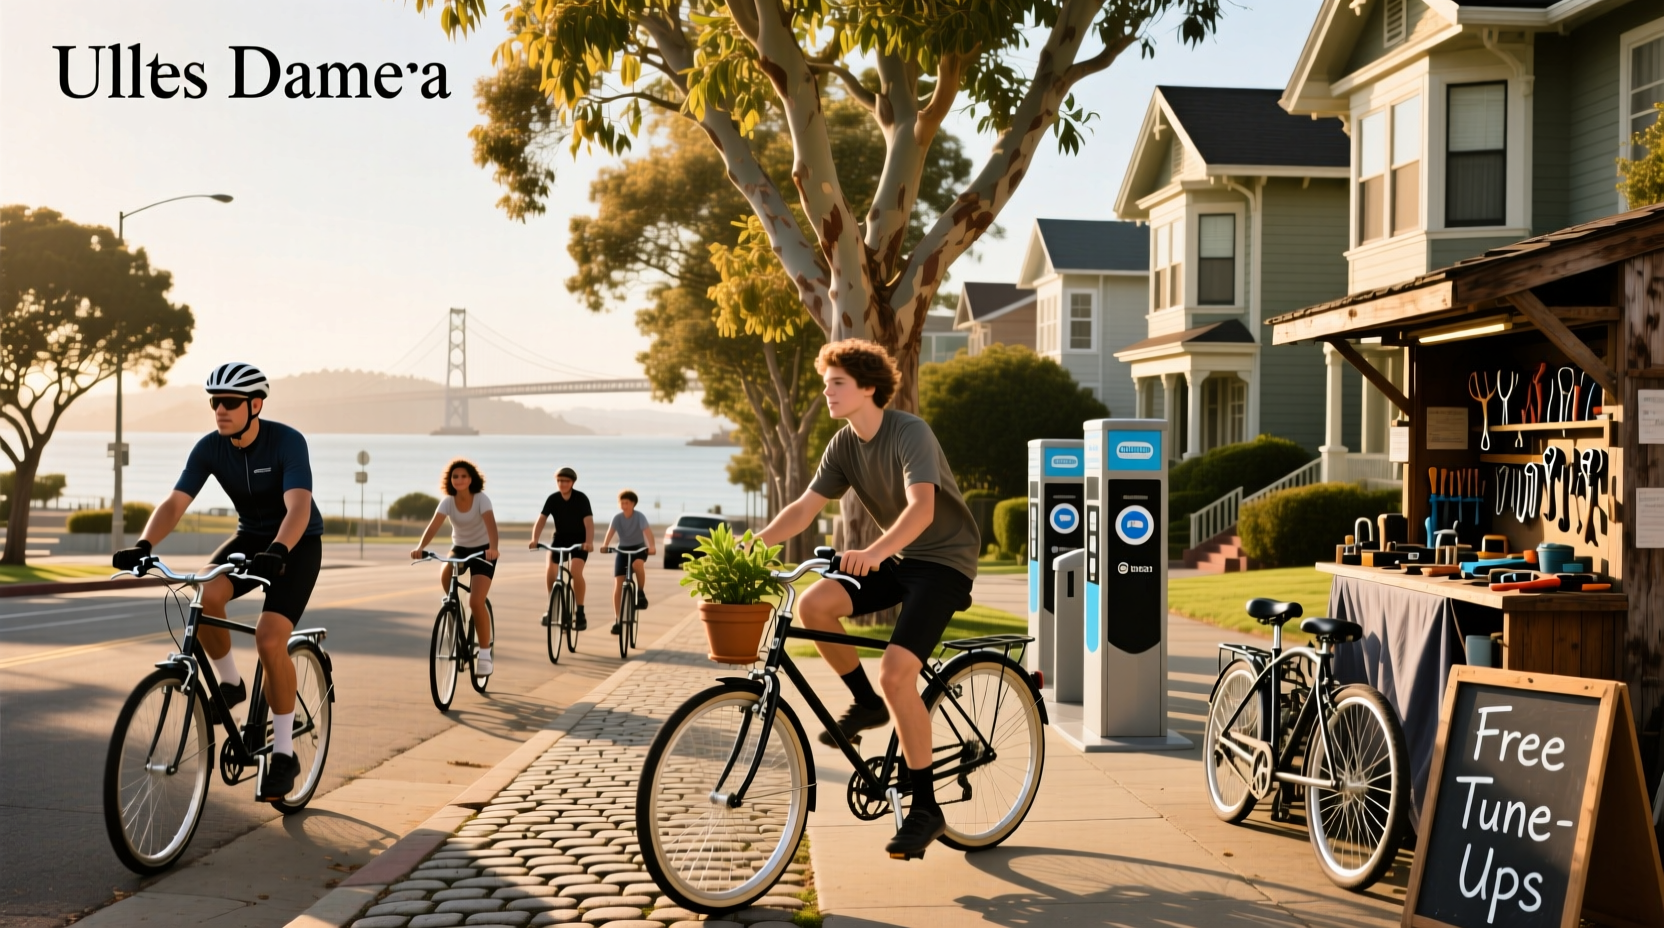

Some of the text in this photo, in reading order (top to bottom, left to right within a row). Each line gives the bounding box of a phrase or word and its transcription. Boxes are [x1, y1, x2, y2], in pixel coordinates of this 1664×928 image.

[1473, 705, 1566, 772] Free
[1455, 776, 1574, 842] Tune-
[1459, 843, 1543, 924] Ups
